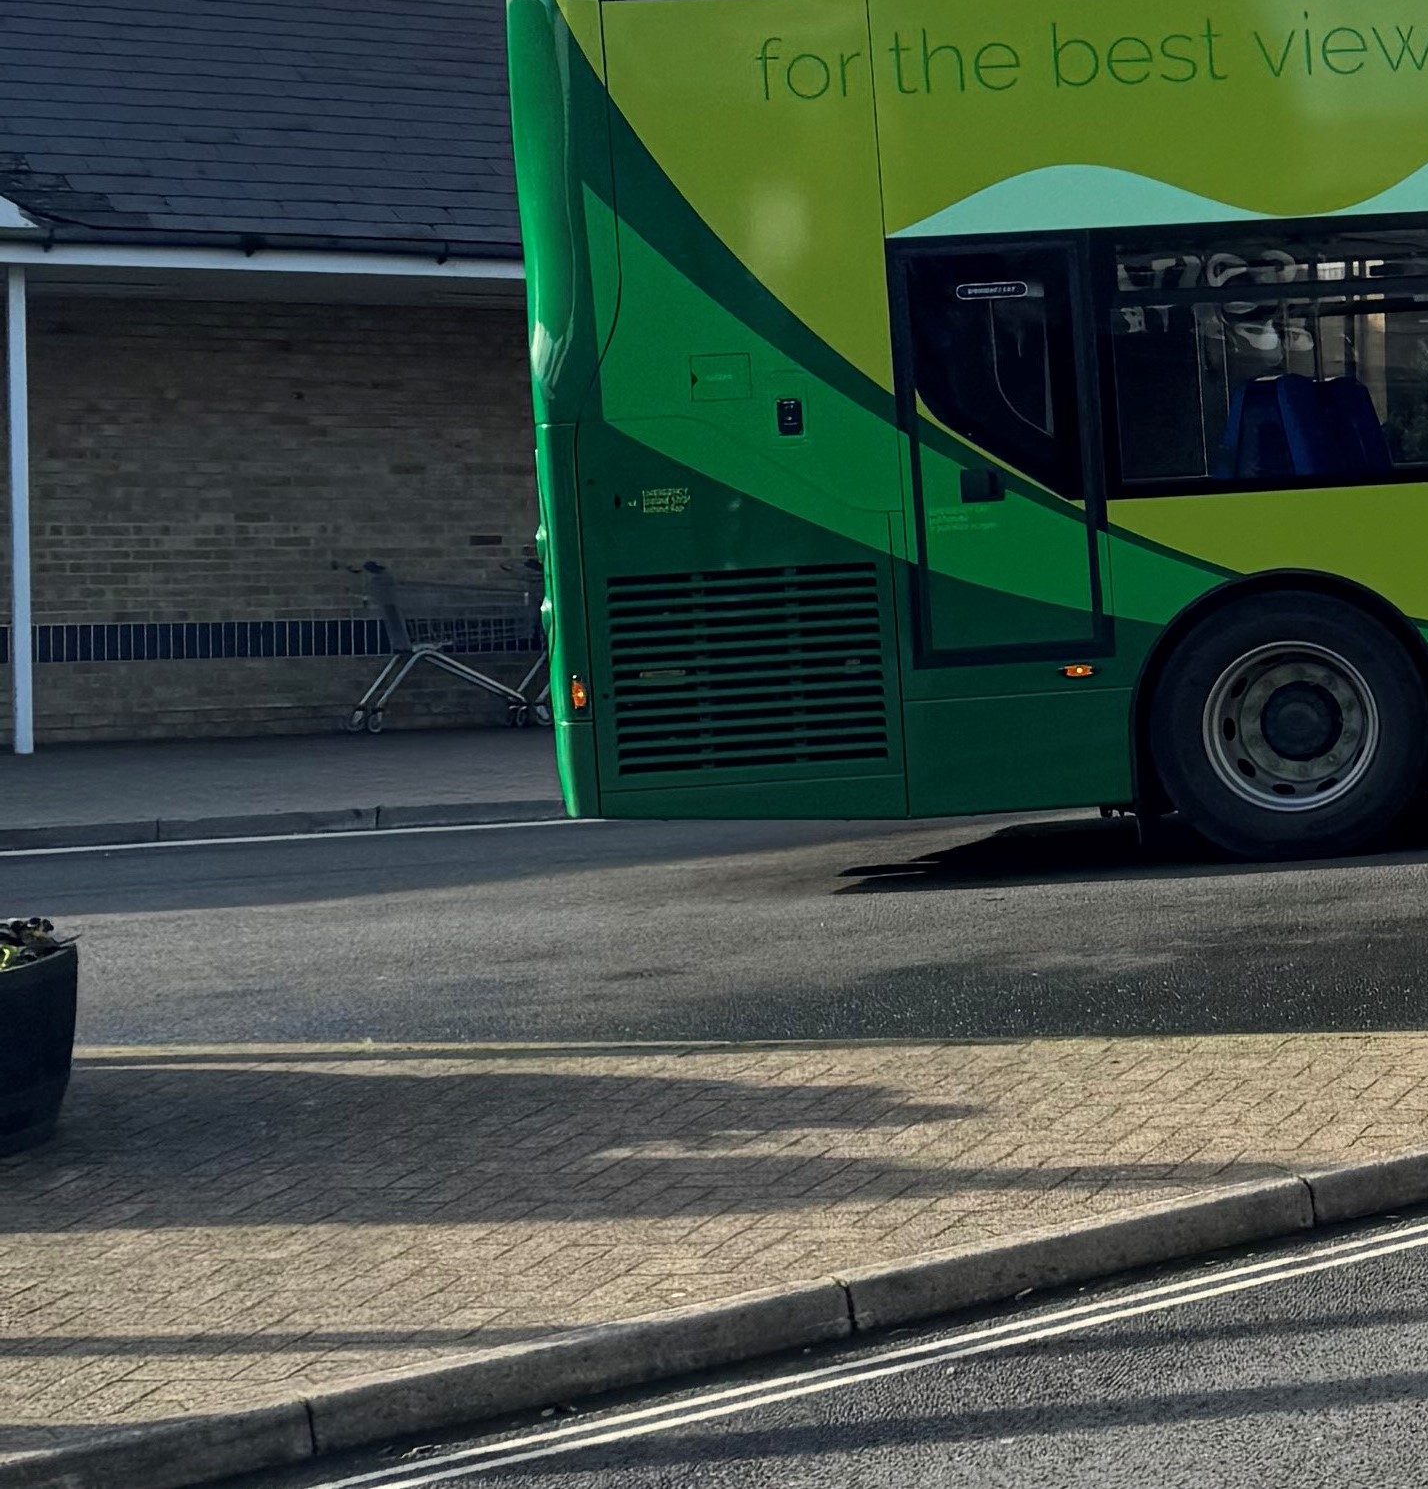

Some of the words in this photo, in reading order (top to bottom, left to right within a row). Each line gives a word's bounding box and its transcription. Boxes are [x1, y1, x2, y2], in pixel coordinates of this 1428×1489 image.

[756, 36, 872, 101] for
[889, 28, 1021, 94] the
[1052, 17, 1228, 87] best
